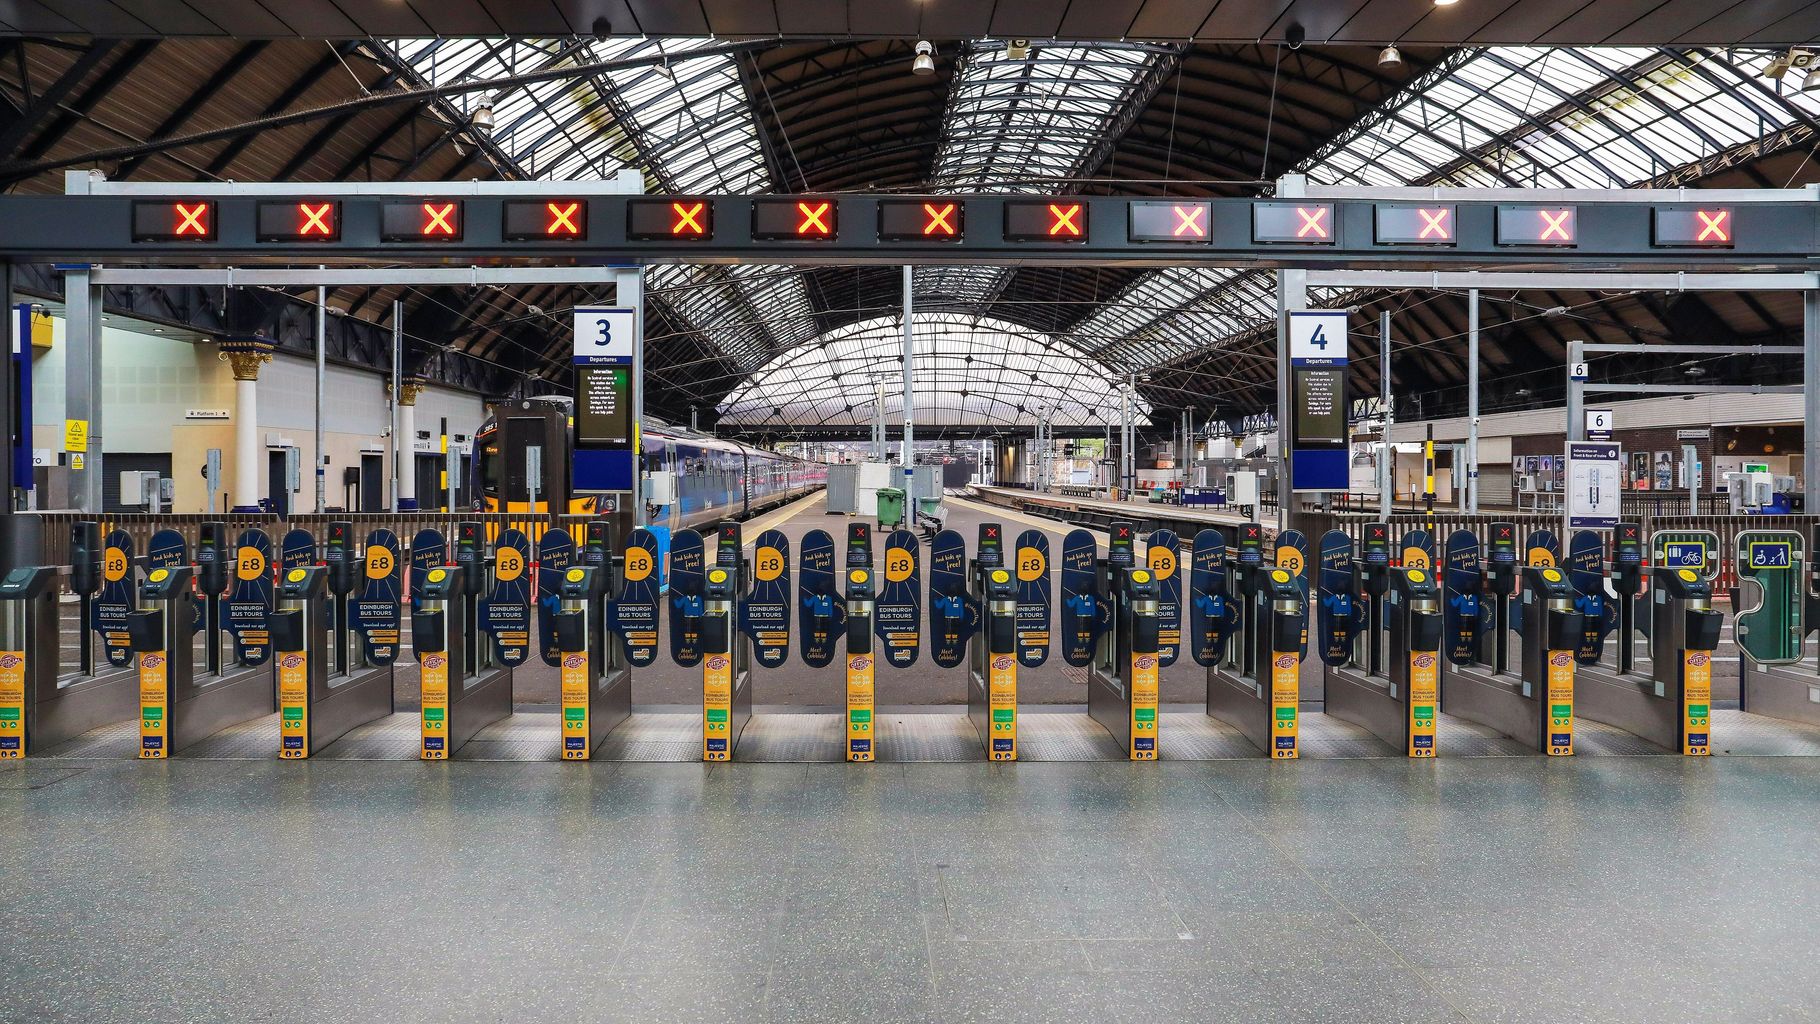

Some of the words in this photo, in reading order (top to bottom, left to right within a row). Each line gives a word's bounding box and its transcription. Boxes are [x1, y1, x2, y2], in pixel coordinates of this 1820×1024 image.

[594, 319, 612, 346] 3
[1310, 324, 1328, 350] 4
[1576, 364, 1583, 375] 6
[1596, 415, 1603, 426] 6
[108, 560, 123, 571] £8
[242, 559, 259, 570] £8
[371, 557, 388, 569] £8
[426, 559, 440, 569] free!
[500, 559, 518, 570] £8
[554, 558, 568, 569] free!
[629, 559, 647, 570] £8
[686, 559, 699, 570] free!
[760, 559, 778, 570] £8
[816, 559, 830, 569] free!
[891, 560, 908, 571] £8
[947, 560, 960, 571] free!
[1022, 559, 1040, 570] £8
[1078, 559, 1091, 569] free!
[1153, 558, 1170, 569] £8
[1208, 559, 1221, 570] free!
[1281, 558, 1298, 569] £8
[1334, 559, 1348, 569] free!
[1408, 559, 1424, 568] £8
[1463, 559, 1476, 569] free!
[1586, 561, 1599, 570] free!
